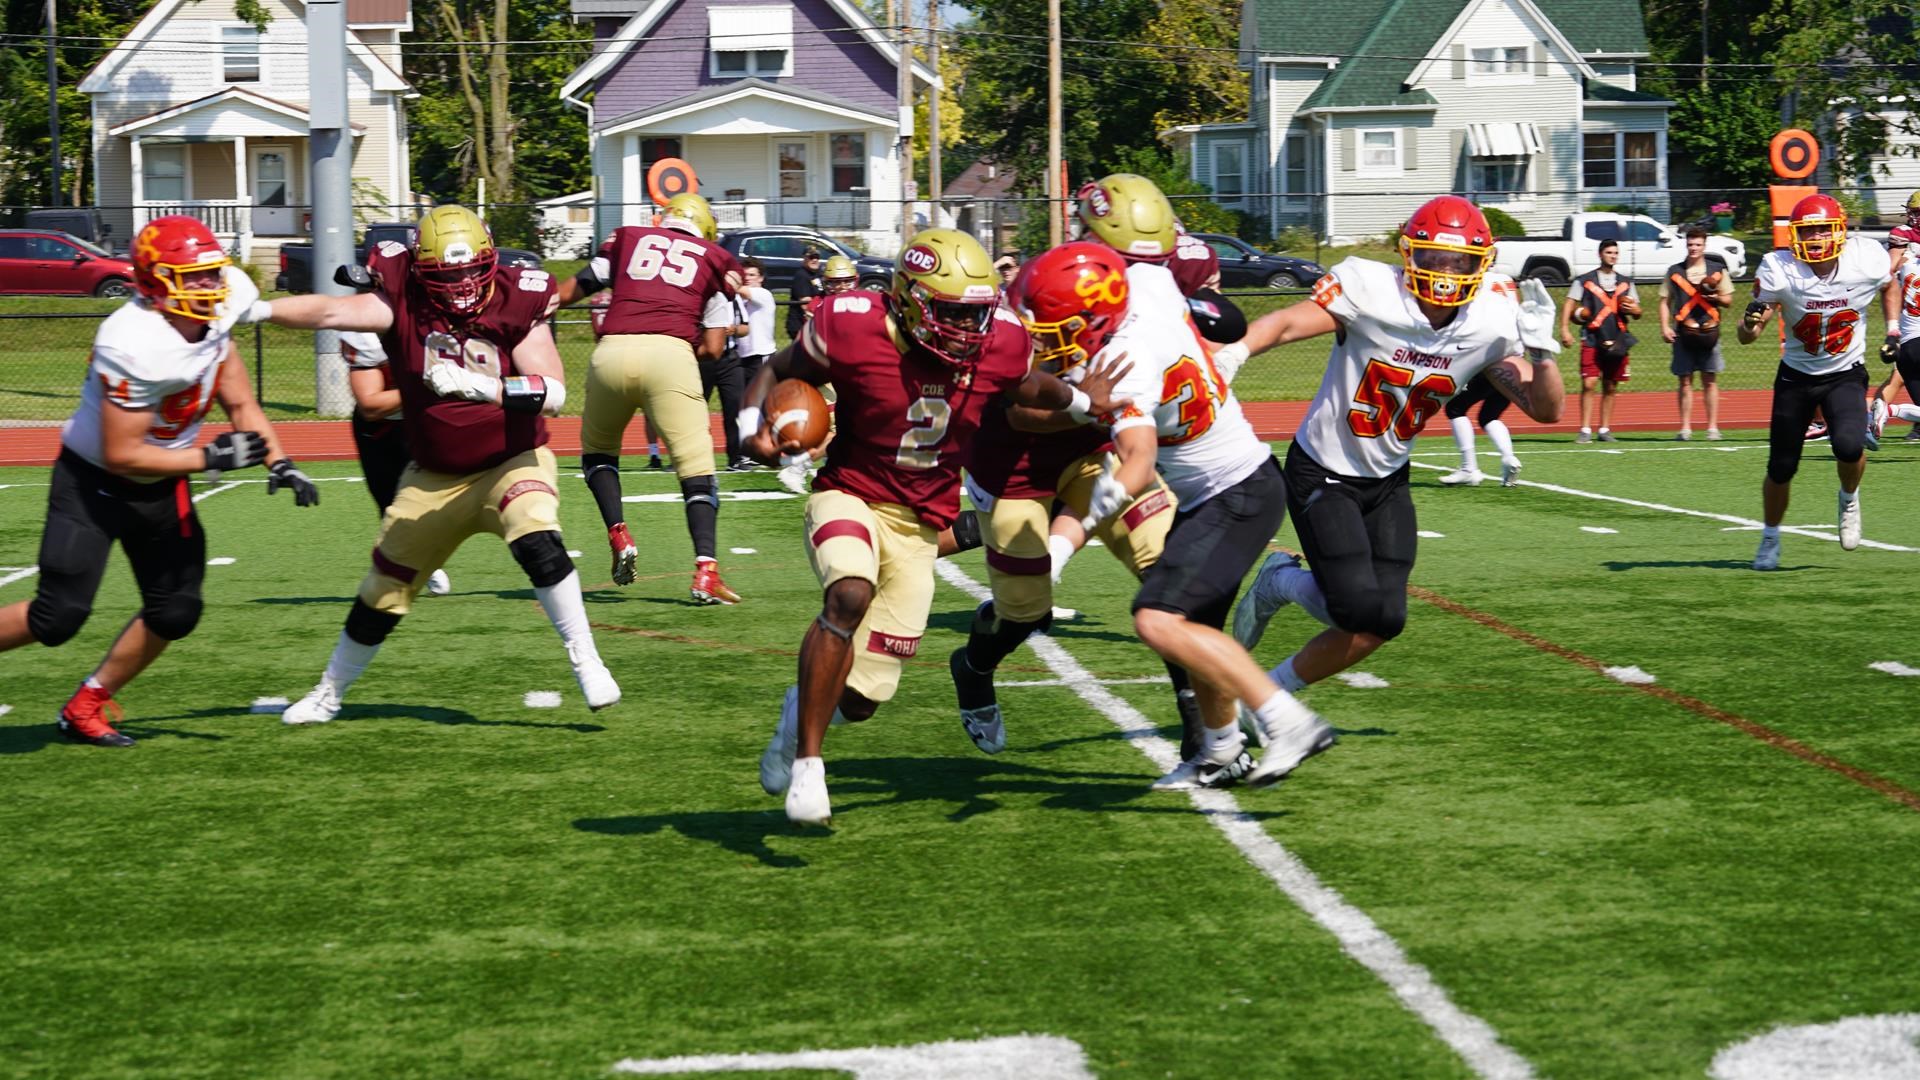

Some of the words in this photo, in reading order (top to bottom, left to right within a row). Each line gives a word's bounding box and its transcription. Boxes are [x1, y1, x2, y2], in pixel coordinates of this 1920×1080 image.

[626, 234, 707, 288] 65
[904, 248, 936, 270] COE
[1074, 269, 1127, 309] SC
[1805, 298, 1849, 310] SIMPSON
[1792, 308, 1861, 356] 46
[1392, 348, 1453, 370] SIMPSON
[921, 384, 945, 396] COE
[1347, 357, 1457, 441] 56
[896, 397, 951, 468] 2
